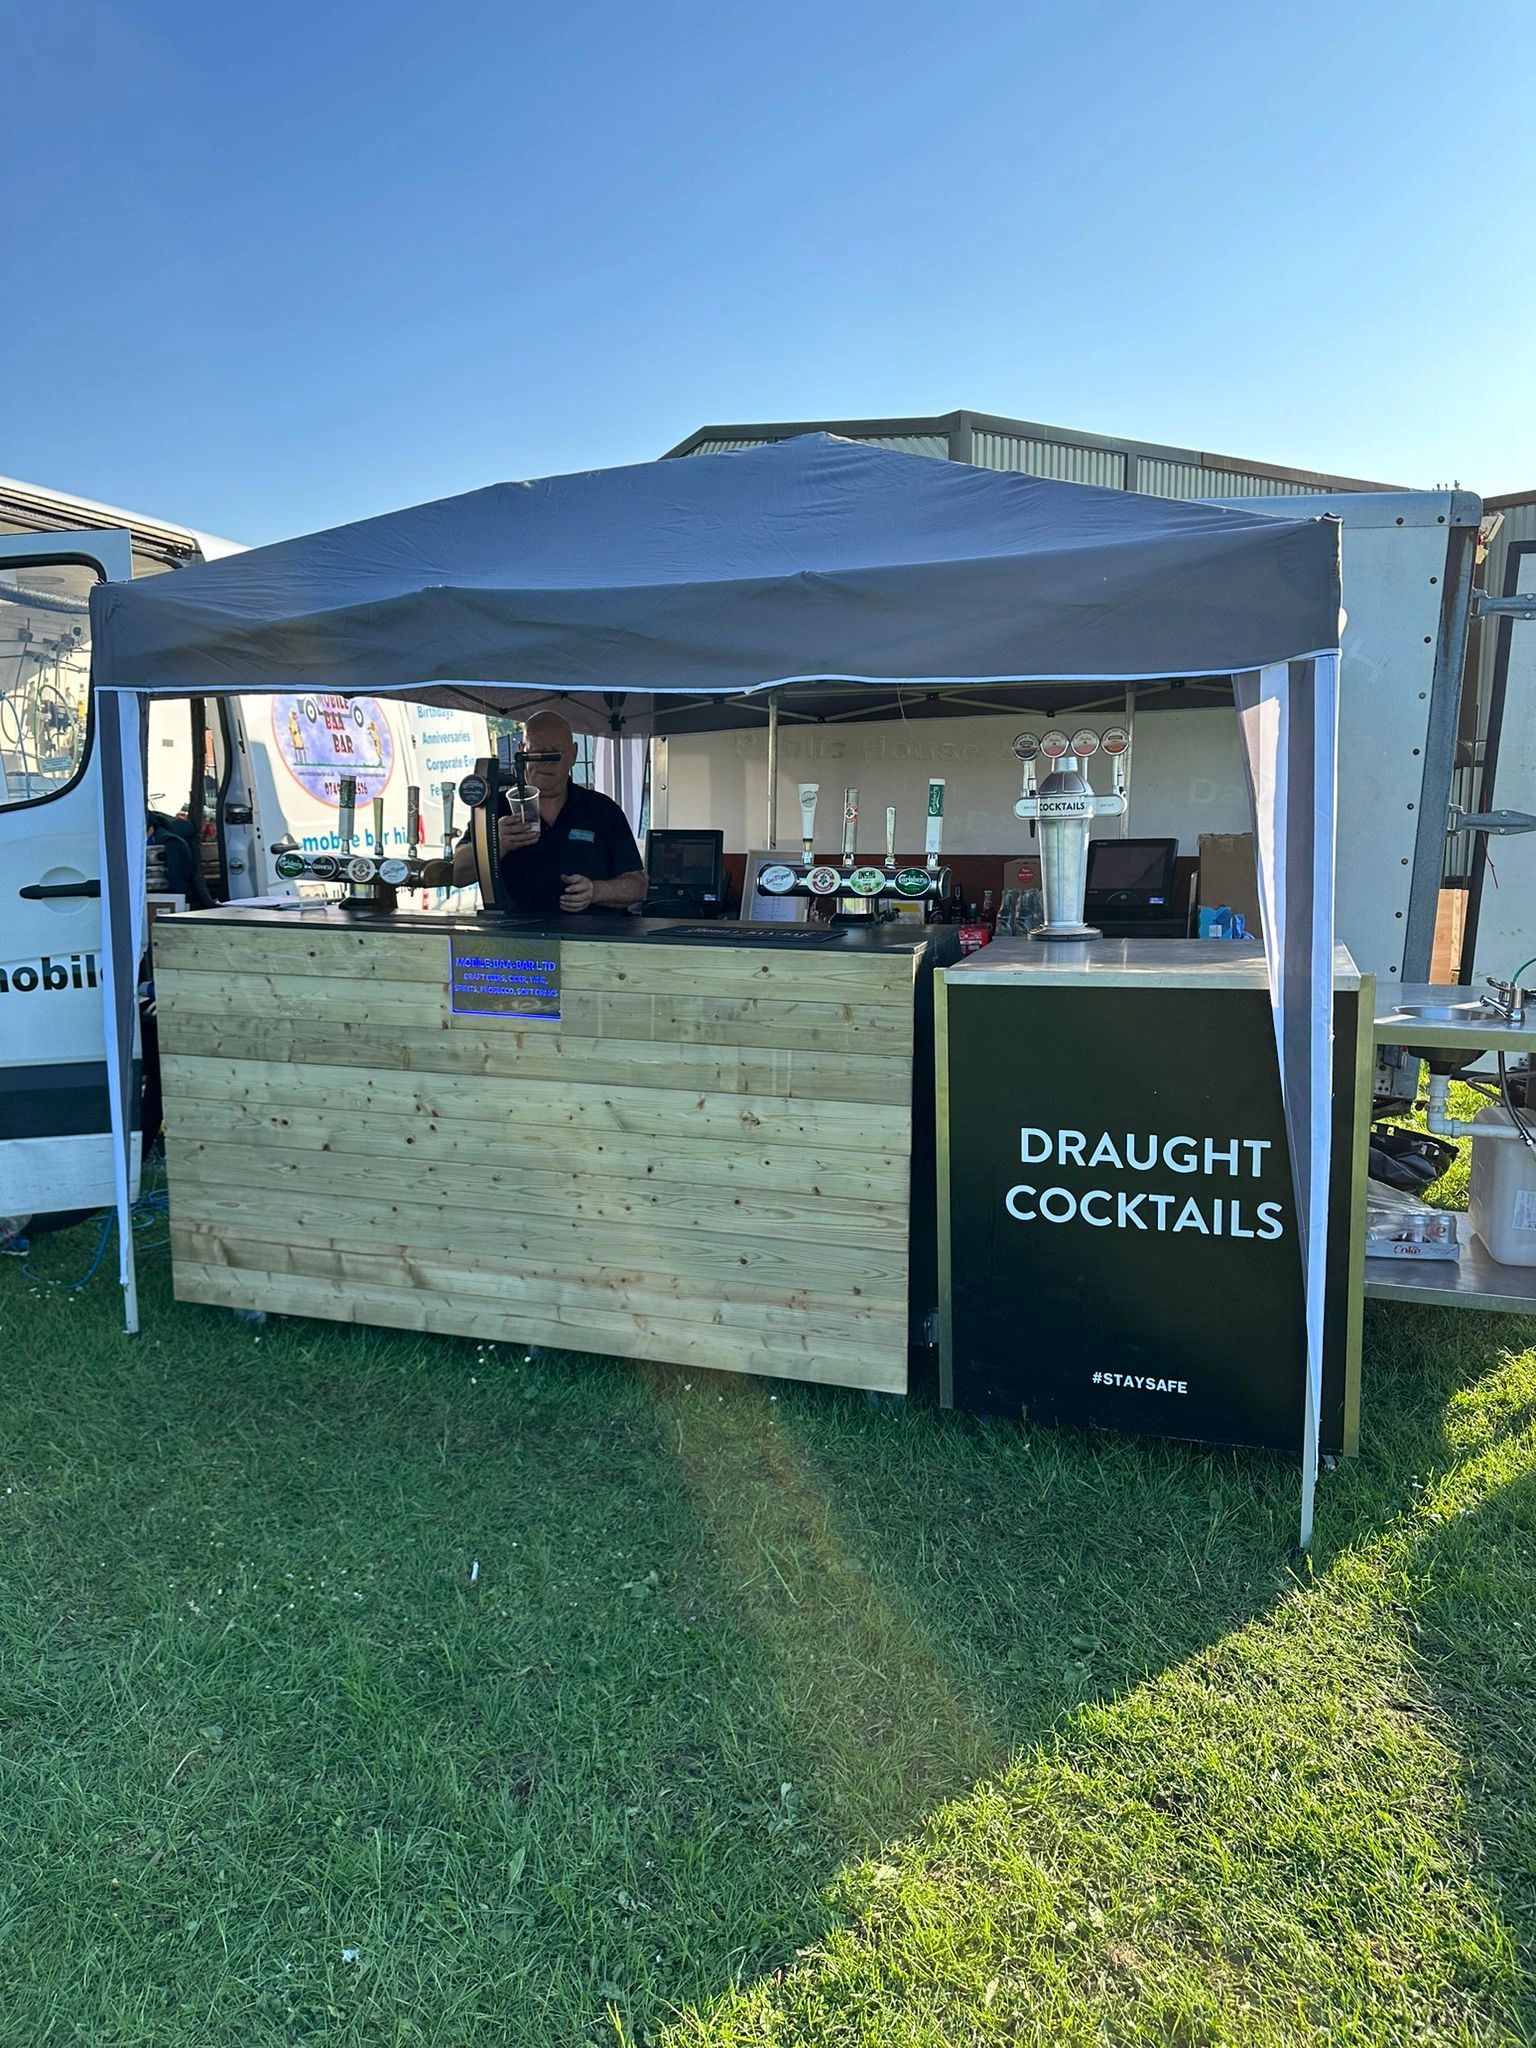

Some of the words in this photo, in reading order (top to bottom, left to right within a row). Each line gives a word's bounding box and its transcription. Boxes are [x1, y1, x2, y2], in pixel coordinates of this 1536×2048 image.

[324, 711, 346, 731] BAA
[331, 733, 354, 754] BAR
[422, 730, 472, 746] Anniversaries
[426, 757, 462, 774] Corporate
[302, 830, 360, 852] mobe
[364, 828, 390, 847] br
[0, 954, 103, 993] obil
[463, 972, 485, 981] DRAFT
[535, 961, 556, 972] LTD
[517, 987, 534, 996] SOFT
[1020, 1127, 1272, 1178] DRAUGHT
[1005, 1184, 1284, 1240] COCKTAILS
[1091, 1371, 1188, 1395] #STAYSAFE
